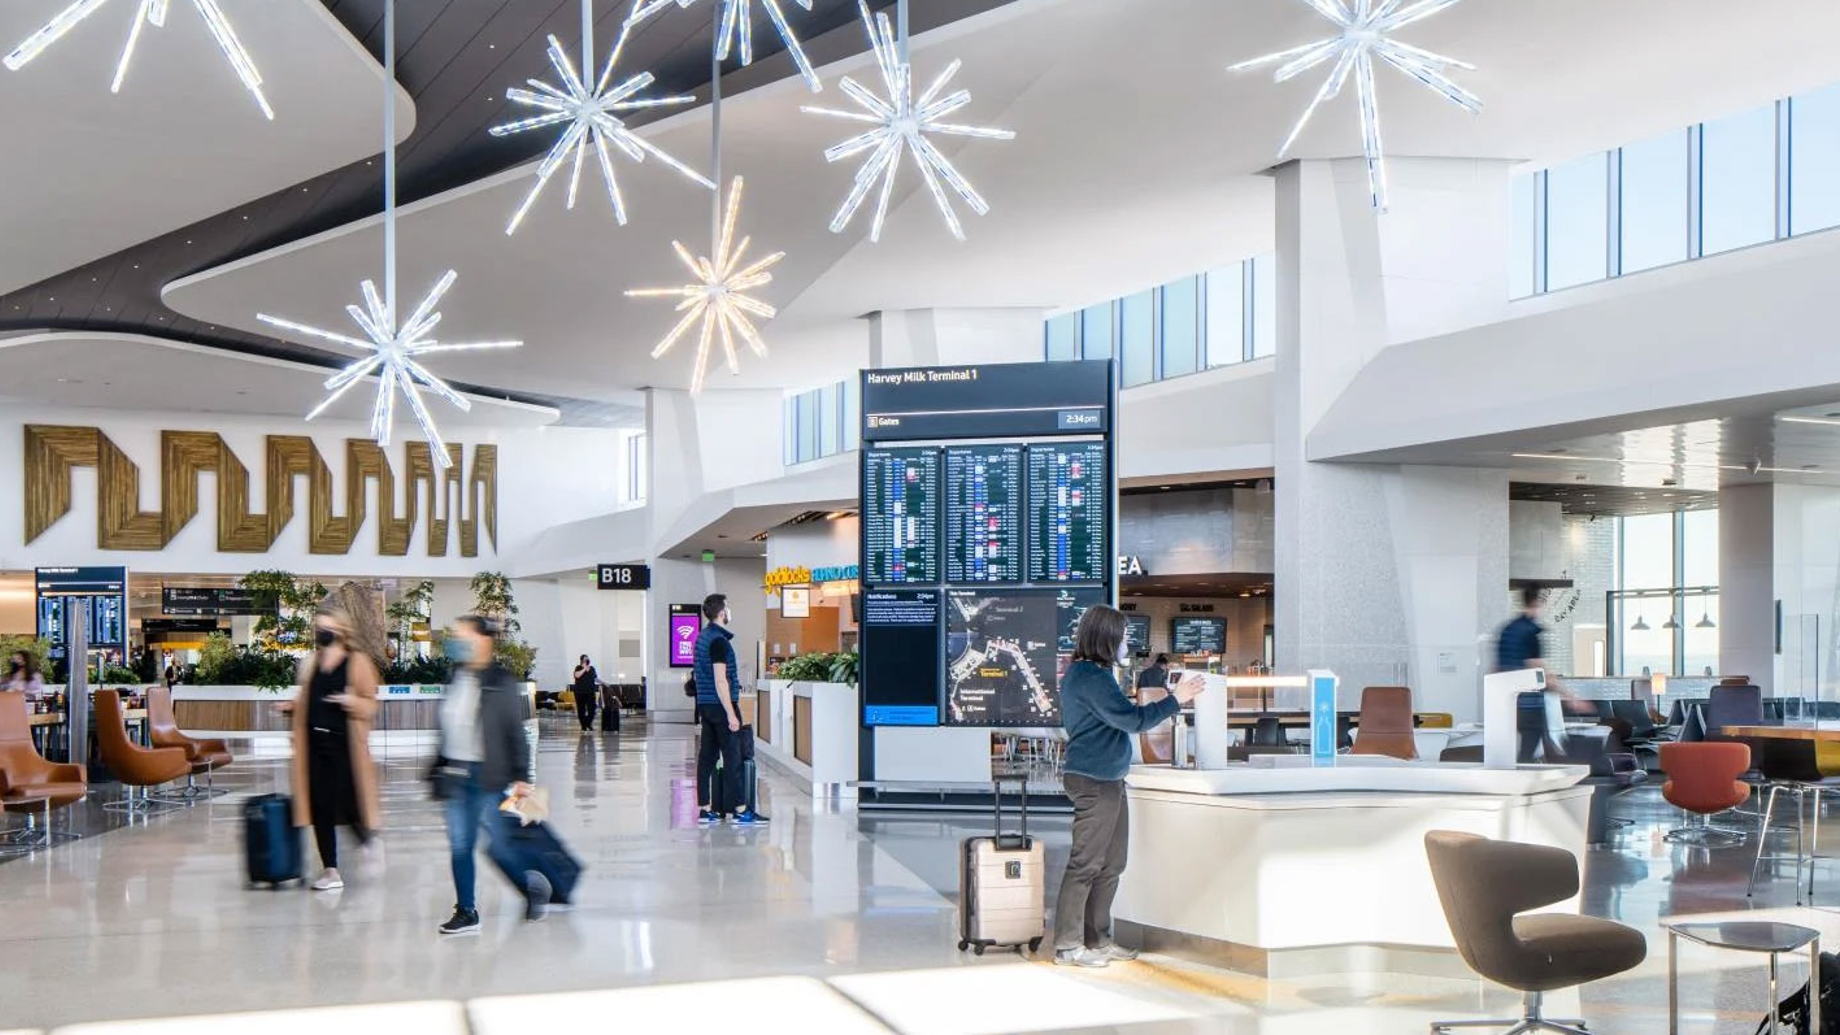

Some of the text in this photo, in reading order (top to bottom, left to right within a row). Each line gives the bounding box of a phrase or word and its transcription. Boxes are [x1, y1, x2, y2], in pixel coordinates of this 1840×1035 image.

[868, 368, 977, 385] Harvey Milk Terminal 1
[879, 417, 900, 426] Gates
[602, 567, 632, 584] B18
